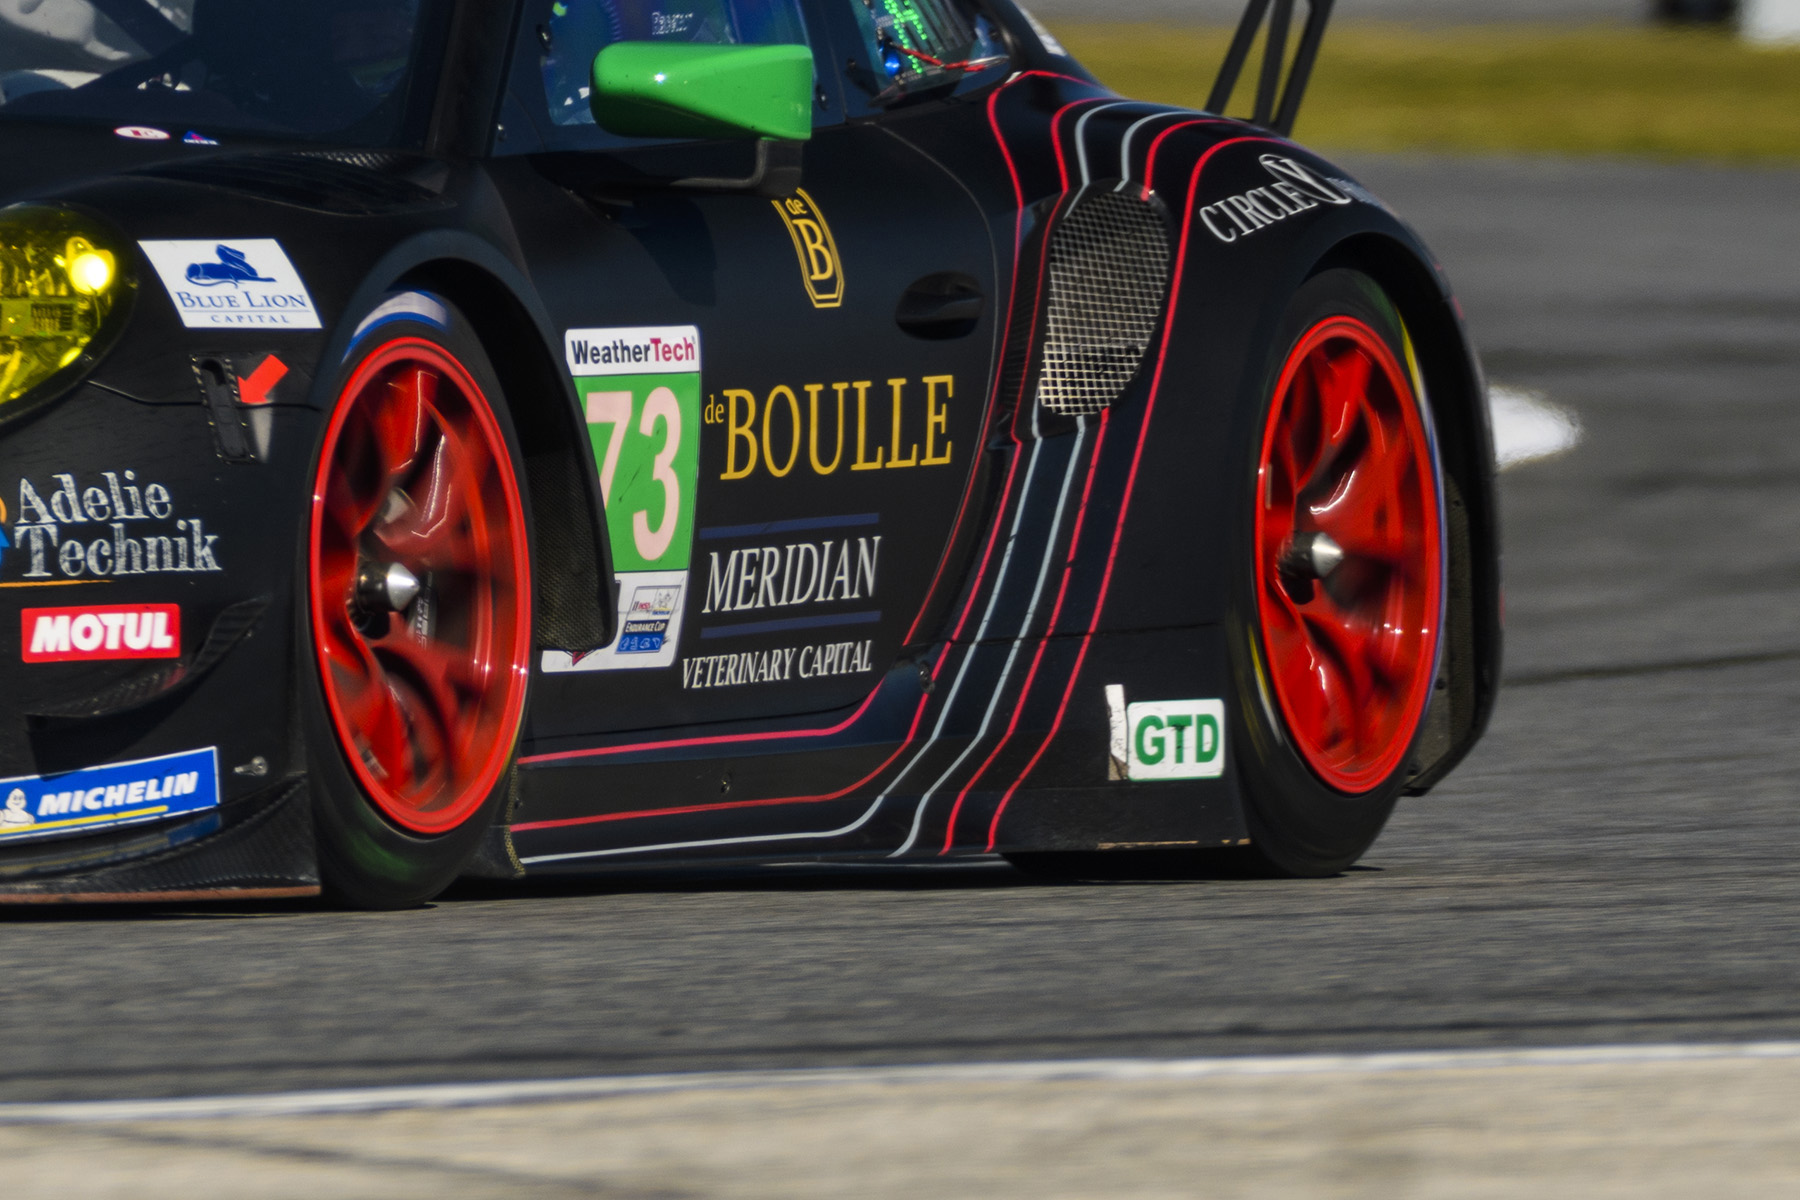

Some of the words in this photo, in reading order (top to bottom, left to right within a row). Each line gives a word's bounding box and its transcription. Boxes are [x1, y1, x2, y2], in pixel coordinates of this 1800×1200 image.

[1199, 181, 1319, 243] CIRCLE
[792, 218, 834, 280] B
[175, 290, 240, 308] BLUE
[242, 290, 308, 309] LION
[210, 314, 291, 324] CAPITAL
[571, 337, 696, 365] WeatherTech
[720, 375, 953, 481] BOULLE
[17, 469, 173, 525] Adelie
[586, 386, 682, 561] 73
[13, 518, 223, 578] Technik
[701, 536, 882, 614] MERIDIAN
[29, 611, 174, 653] MOTUL
[682, 646, 797, 690] VETERINARY
[798, 639, 873, 679] CAPITAL
[1135, 713, 1220, 766] GTD
[37, 770, 199, 817] MICHELIN
